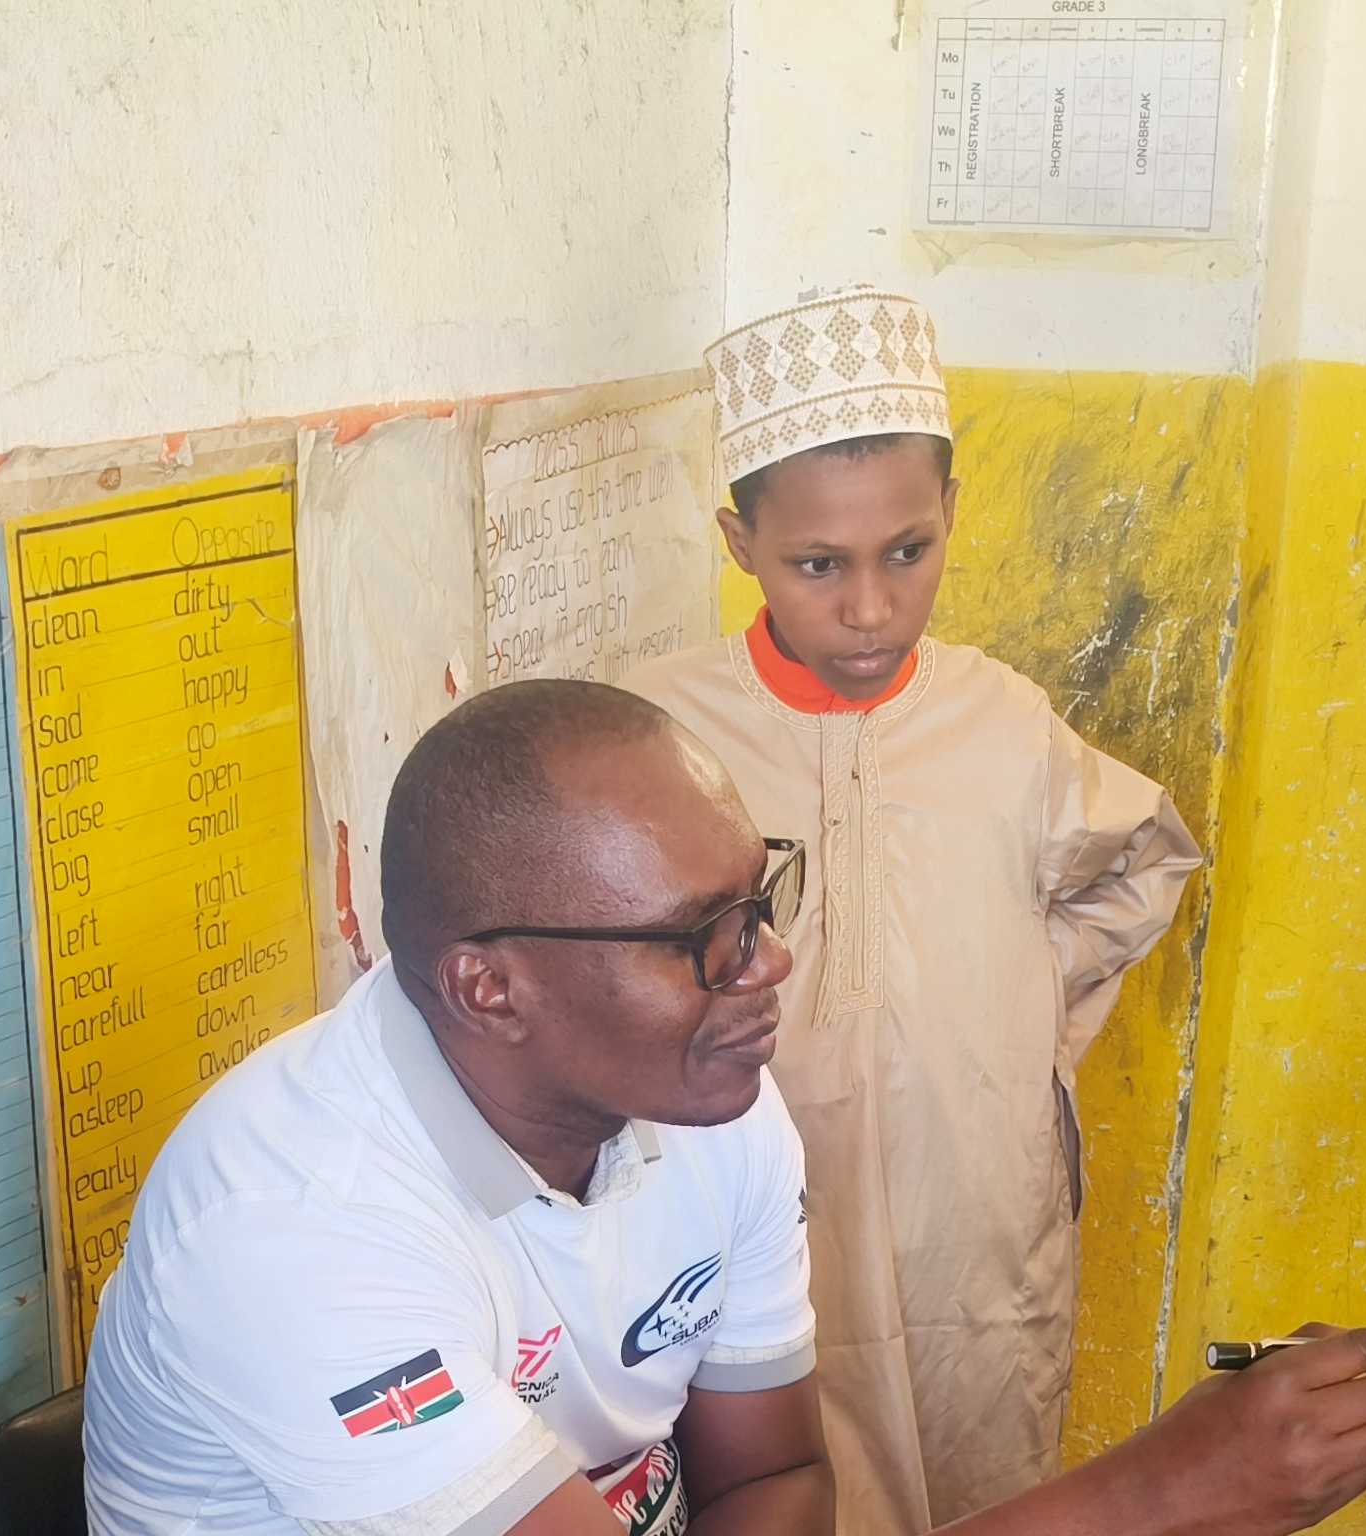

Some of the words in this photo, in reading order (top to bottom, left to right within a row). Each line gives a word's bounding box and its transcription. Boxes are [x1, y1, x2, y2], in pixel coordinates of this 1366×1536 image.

[1052, 1, 1094, 12] GRADE
[1096, 1, 1106, 12] 3
[942, 53, 958, 63] Mo
[942, 89, 956, 100] Tu
[938, 126, 956, 137] We
[966, 82, 981, 180] REGISTRATION
[1050, 87, 1066, 178] SHORTBREAK
[1136, 92, 1152, 175] LONGBREAK
[938, 162, 951, 172] Th
[937, 198, 949, 208] Fr
[26, 533, 108, 595] Word
[172, 513, 276, 567] Opposite
[174, 572, 232, 622] dirty
[31, 607, 100, 648] clean
[179, 623, 223, 662] out
[38, 665, 65, 697] in
[182, 665, 249, 713] happy
[188, 722, 216, 767] go
[41, 754, 99, 798] come
[188, 760, 242, 806] open
[46, 800, 104, 844] close
[188, 793, 240, 846] small
[50, 848, 90, 897] big
[195, 855, 249, 917] right
[57, 908, 101, 958] left
[195, 912, 231, 952] far
[60, 962, 118, 1006] near
[196, 995, 256, 1038] down
[67, 1060, 102, 1096] up
[70, 1088, 144, 1138] asleep
[75, 1146, 138, 1202] early
